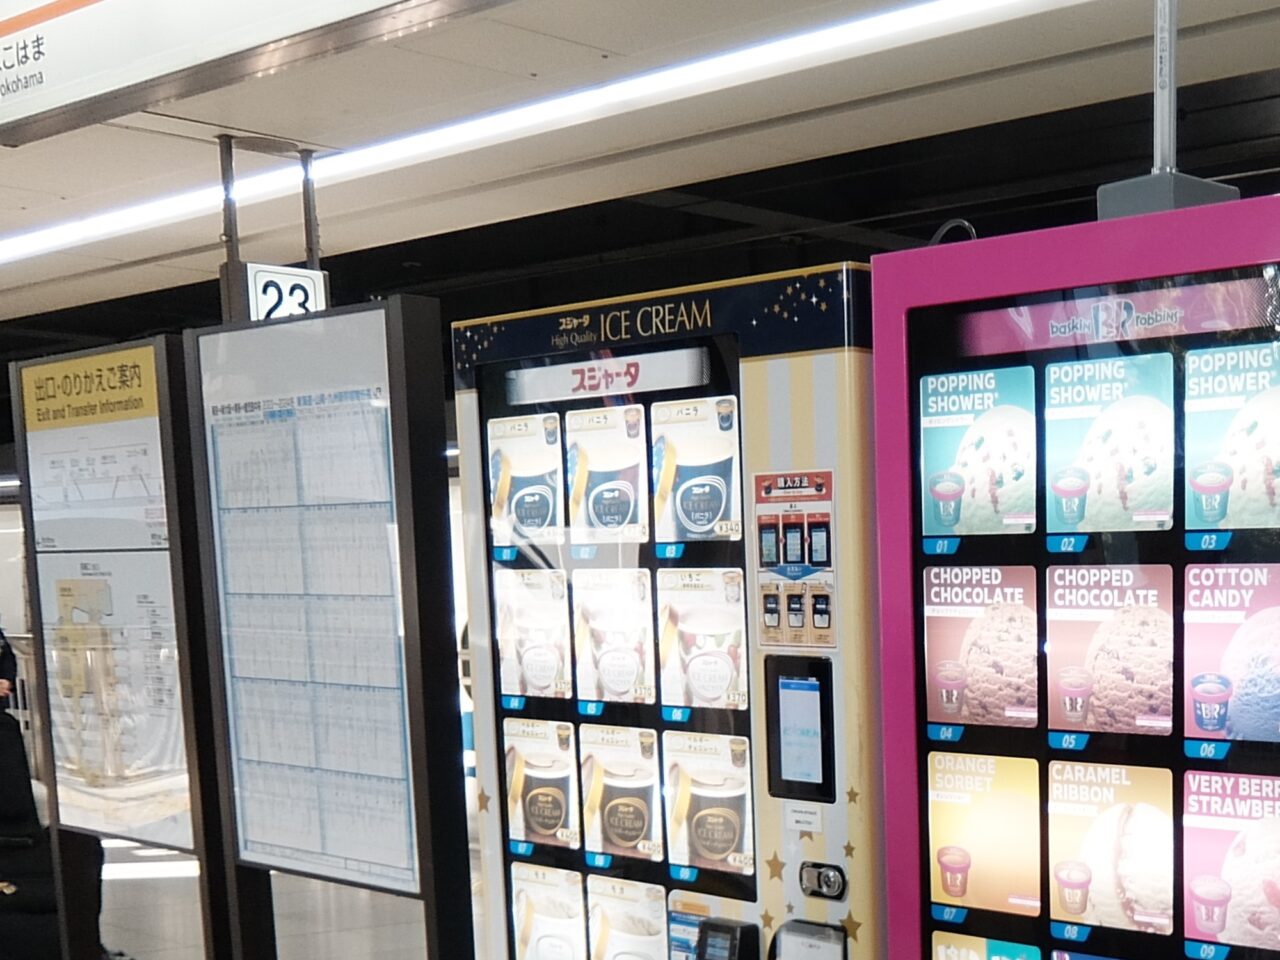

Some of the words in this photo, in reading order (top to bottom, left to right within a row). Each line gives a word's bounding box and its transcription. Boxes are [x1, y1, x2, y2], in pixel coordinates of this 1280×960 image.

[0, 34, 45, 71] こはま
[261, 279, 311, 320] 23
[600, 310, 631, 342] ICE
[636, 299, 712, 337] CREAM
[551, 335, 569, 349] High
[1188, 348, 1273, 374] POPPING
[571, 361, 640, 393] スジャータ
[1050, 360, 1125, 384] POPPING
[927, 372, 996, 394] POPPING
[37, 407, 51, 422] Exit
[52, 406, 66, 420] and
[67, 402, 98, 418] Transfer
[99, 396, 144, 414] Information
[936, 540, 948, 553] 01
[1060, 537, 1075, 551] 02
[1201, 535, 1217, 549] 03
[930, 567, 1002, 585] CHOPPED
[1053, 568, 1134, 587] CHOPPED
[1188, 567, 1268, 586] COTTON
[930, 586, 1024, 604] CHOCOLATE
[1053, 589, 1159, 607] CHOCOLATE
[1188, 589, 1254, 607] CANDY
[940, 726, 953, 739] 04
[1062, 734, 1076, 748] 05
[1200, 743, 1215, 757] 06
[934, 754, 996, 775] ORANGE
[1052, 763, 1131, 785] CARAMEL
[935, 773, 993, 793] SORBET
[1188, 773, 1235, 794] VERY
[1052, 783, 1114, 803] RIBBON
[944, 907, 956, 920] 07
[1064, 925, 1078, 939] 08
[1200, 944, 1216, 959] 09
